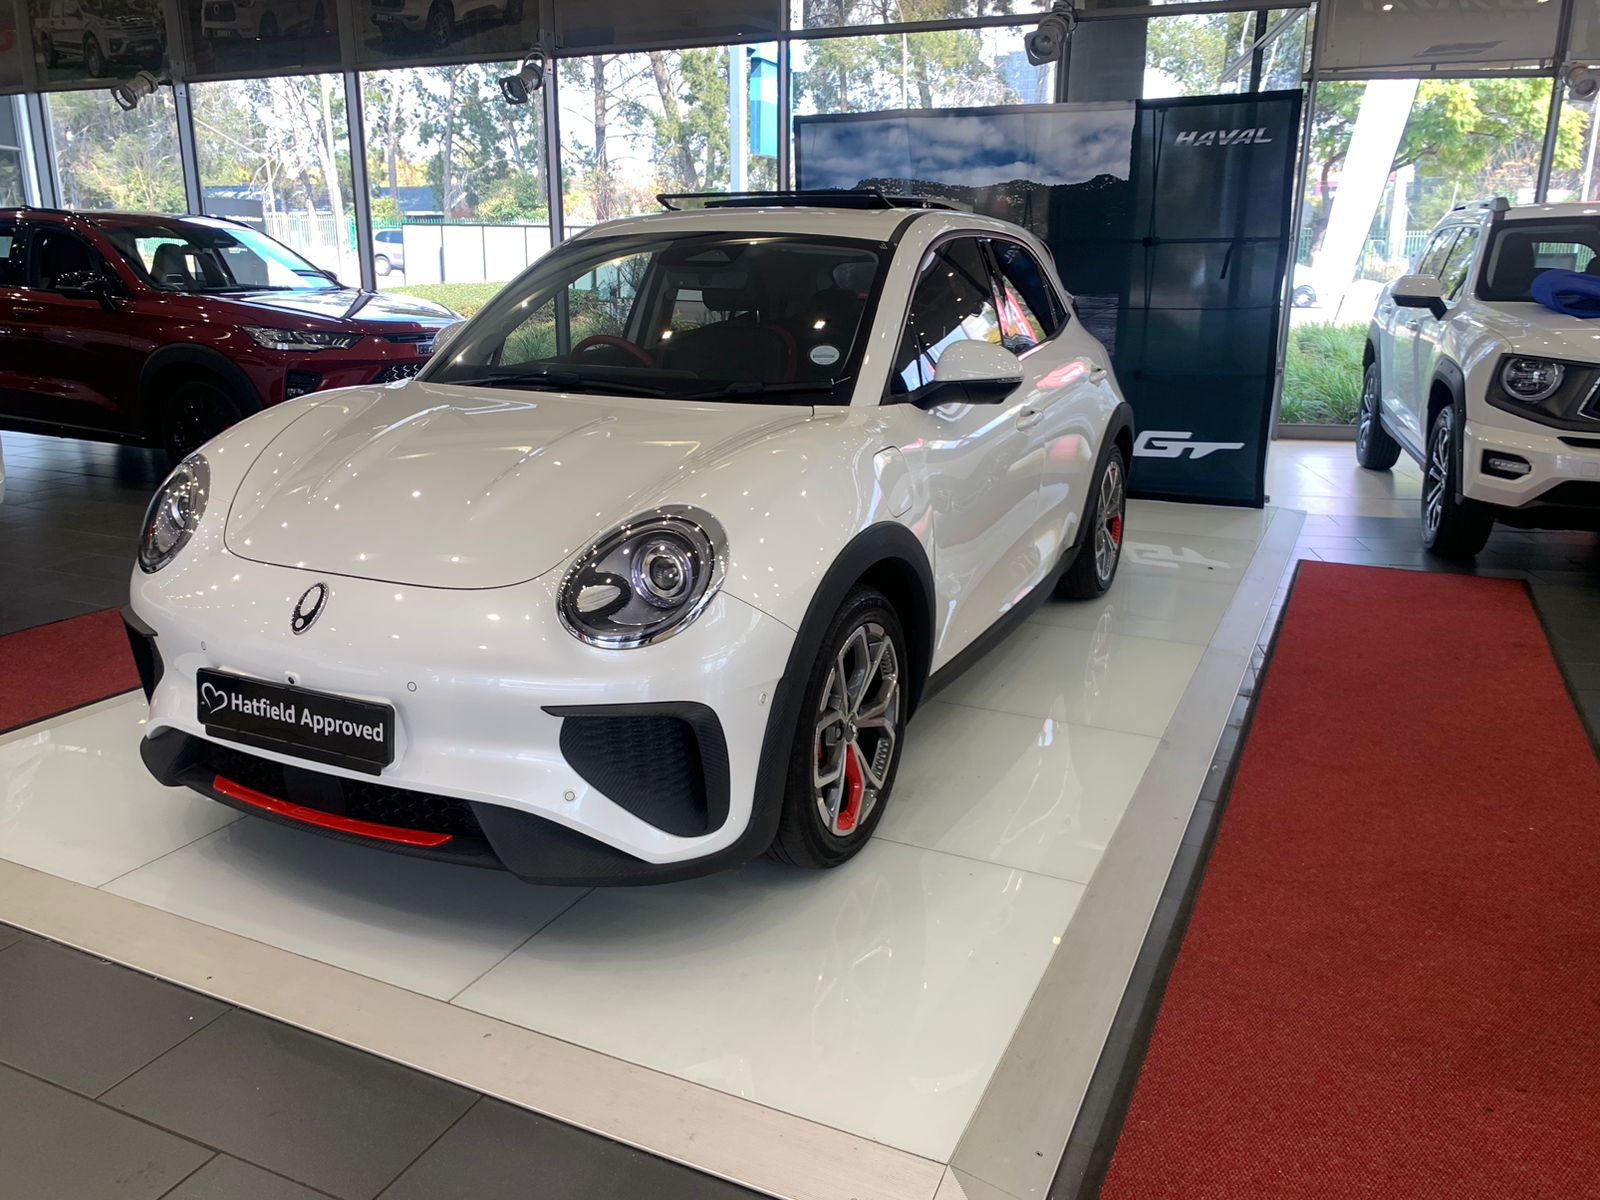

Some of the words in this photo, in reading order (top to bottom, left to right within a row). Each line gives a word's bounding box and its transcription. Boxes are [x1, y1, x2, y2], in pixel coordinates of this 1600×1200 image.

[1174, 127, 1272, 146] HAVAL
[1132, 430, 1245, 459] GT
[231, 692, 296, 724] Hatfield
[300, 708, 384, 742] Approved
